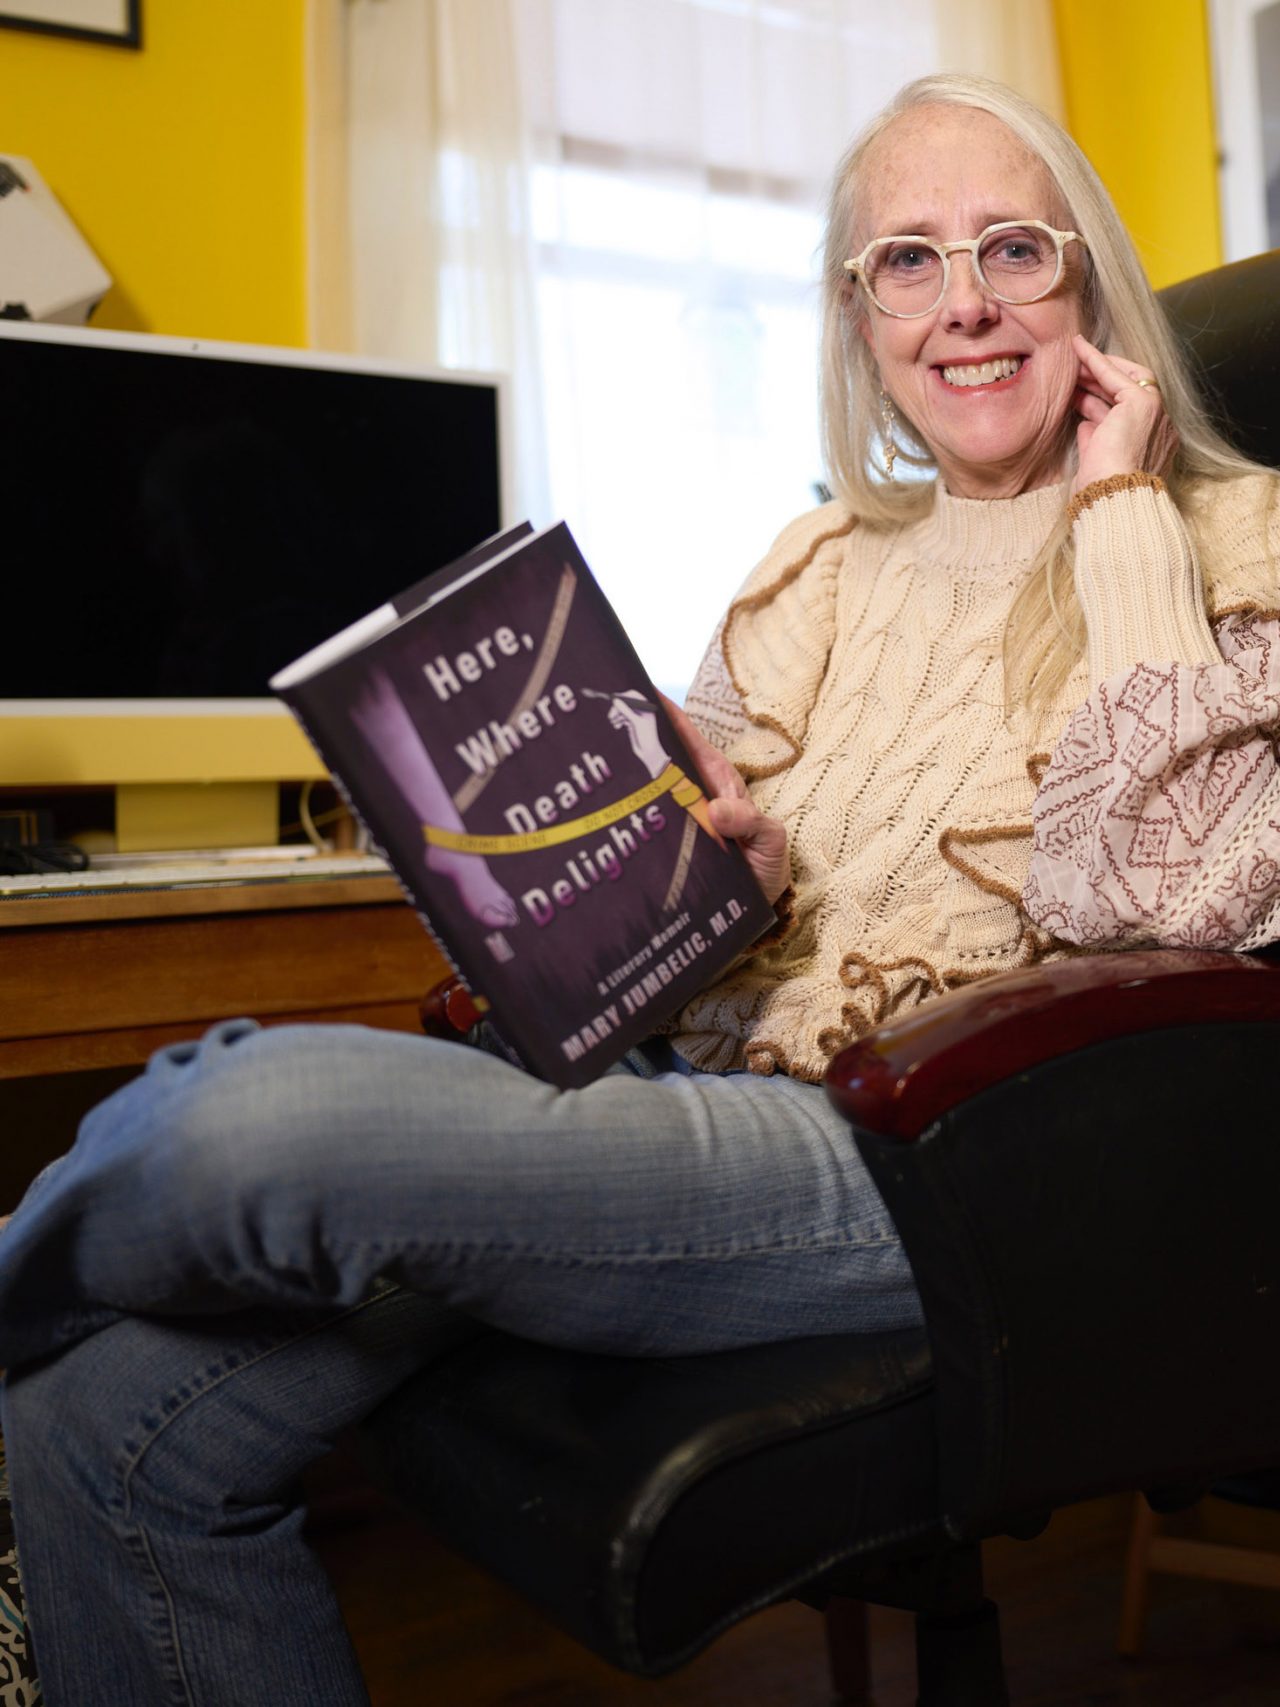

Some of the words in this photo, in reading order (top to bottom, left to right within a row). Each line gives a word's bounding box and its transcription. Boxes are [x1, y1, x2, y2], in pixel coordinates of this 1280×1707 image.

[423, 626, 533, 701] Here,
[455, 684, 577, 775] Where
[504, 752, 612, 836] Death
[604, 805, 625, 823] NOT
[627, 783, 662, 811] CROSS
[521, 804, 666, 926] Delights
[560, 1005, 622, 1062] MARY
[621, 931, 713, 1016] JUMBELIC,
[709, 898, 748, 937] M.D.
[606, 946, 653, 988] Literary
[650, 911, 692, 951] Memoir
